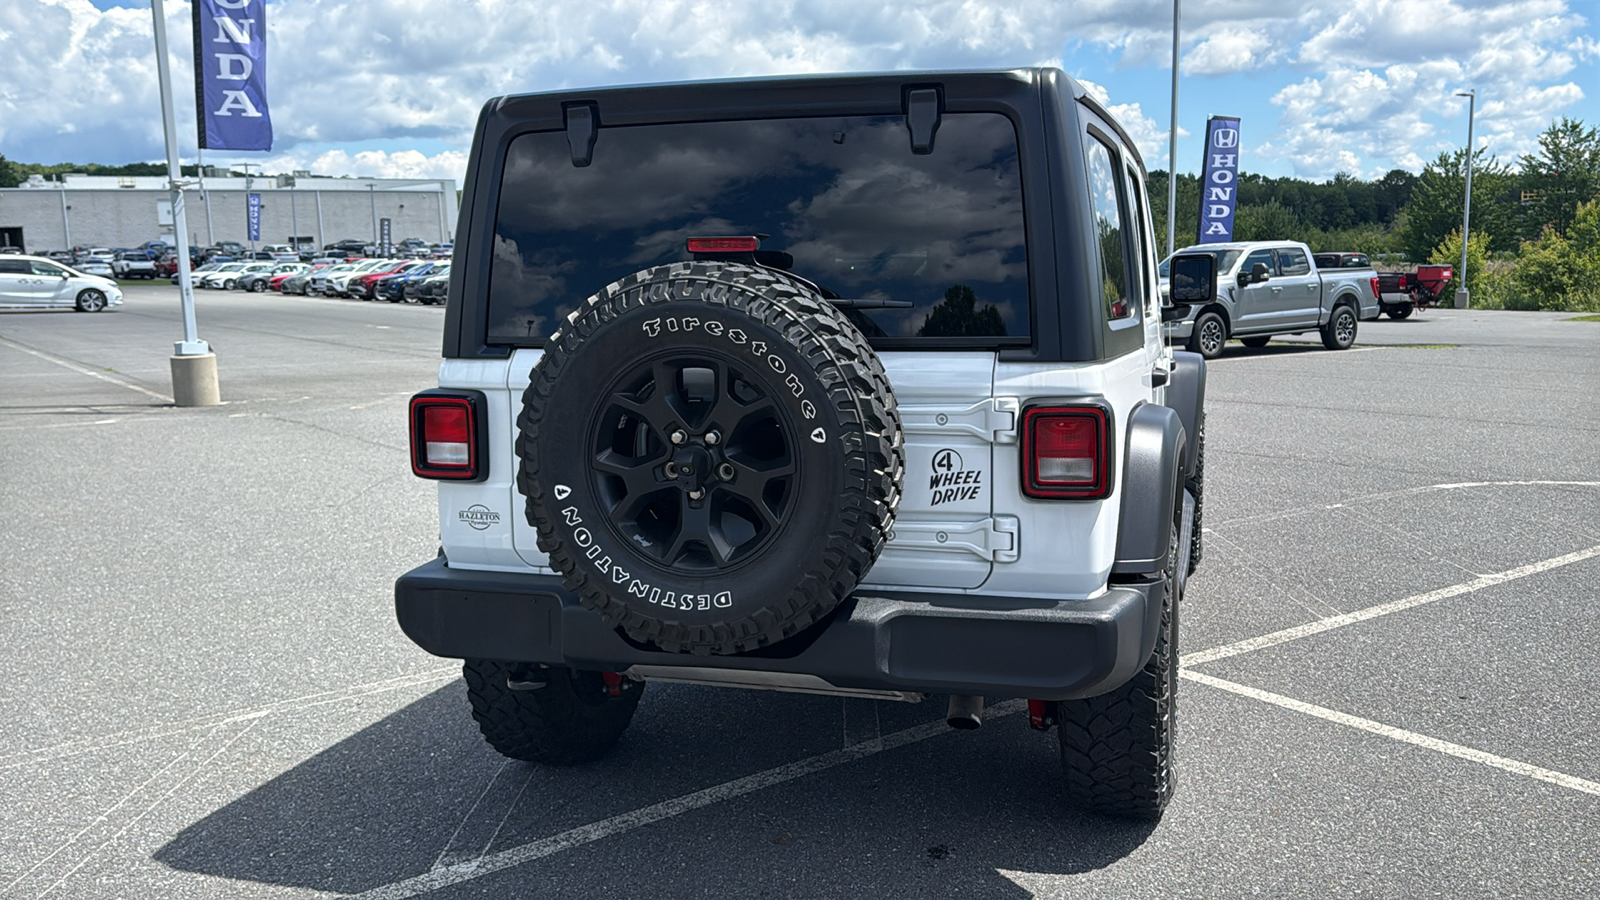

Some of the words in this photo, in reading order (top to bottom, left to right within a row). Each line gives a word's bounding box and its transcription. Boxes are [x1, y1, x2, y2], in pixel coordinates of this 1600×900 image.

[1205, 154, 1236, 235] HONDA
[643, 317, 817, 420] Firestone
[937, 452, 953, 471] 4
[929, 470, 982, 490] WHEEL
[931, 486, 981, 506] DRIVE
[459, 512, 500, 521] HAZLETON
[561, 506, 732, 611] DESTINATION
